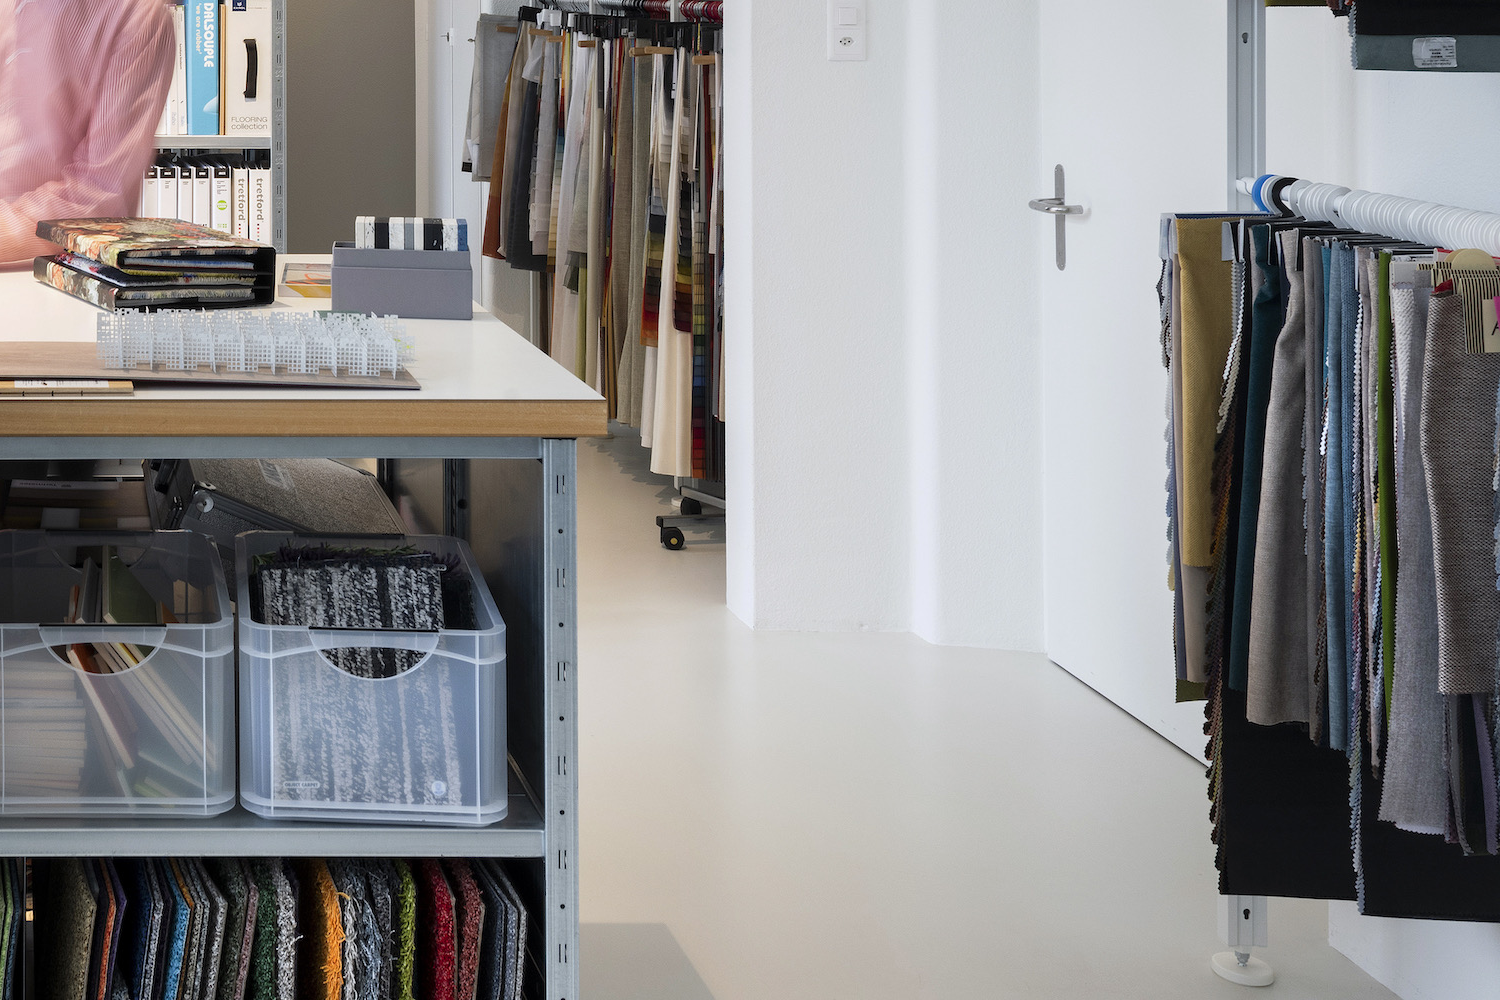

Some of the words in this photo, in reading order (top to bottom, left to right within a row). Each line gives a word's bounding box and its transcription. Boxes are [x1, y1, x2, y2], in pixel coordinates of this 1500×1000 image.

[203, 2, 215, 68] DALSOUPLE
[231, 122, 268, 130] collection
[238, 177, 246, 221] tretford
[256, 177, 264, 221] tretford
